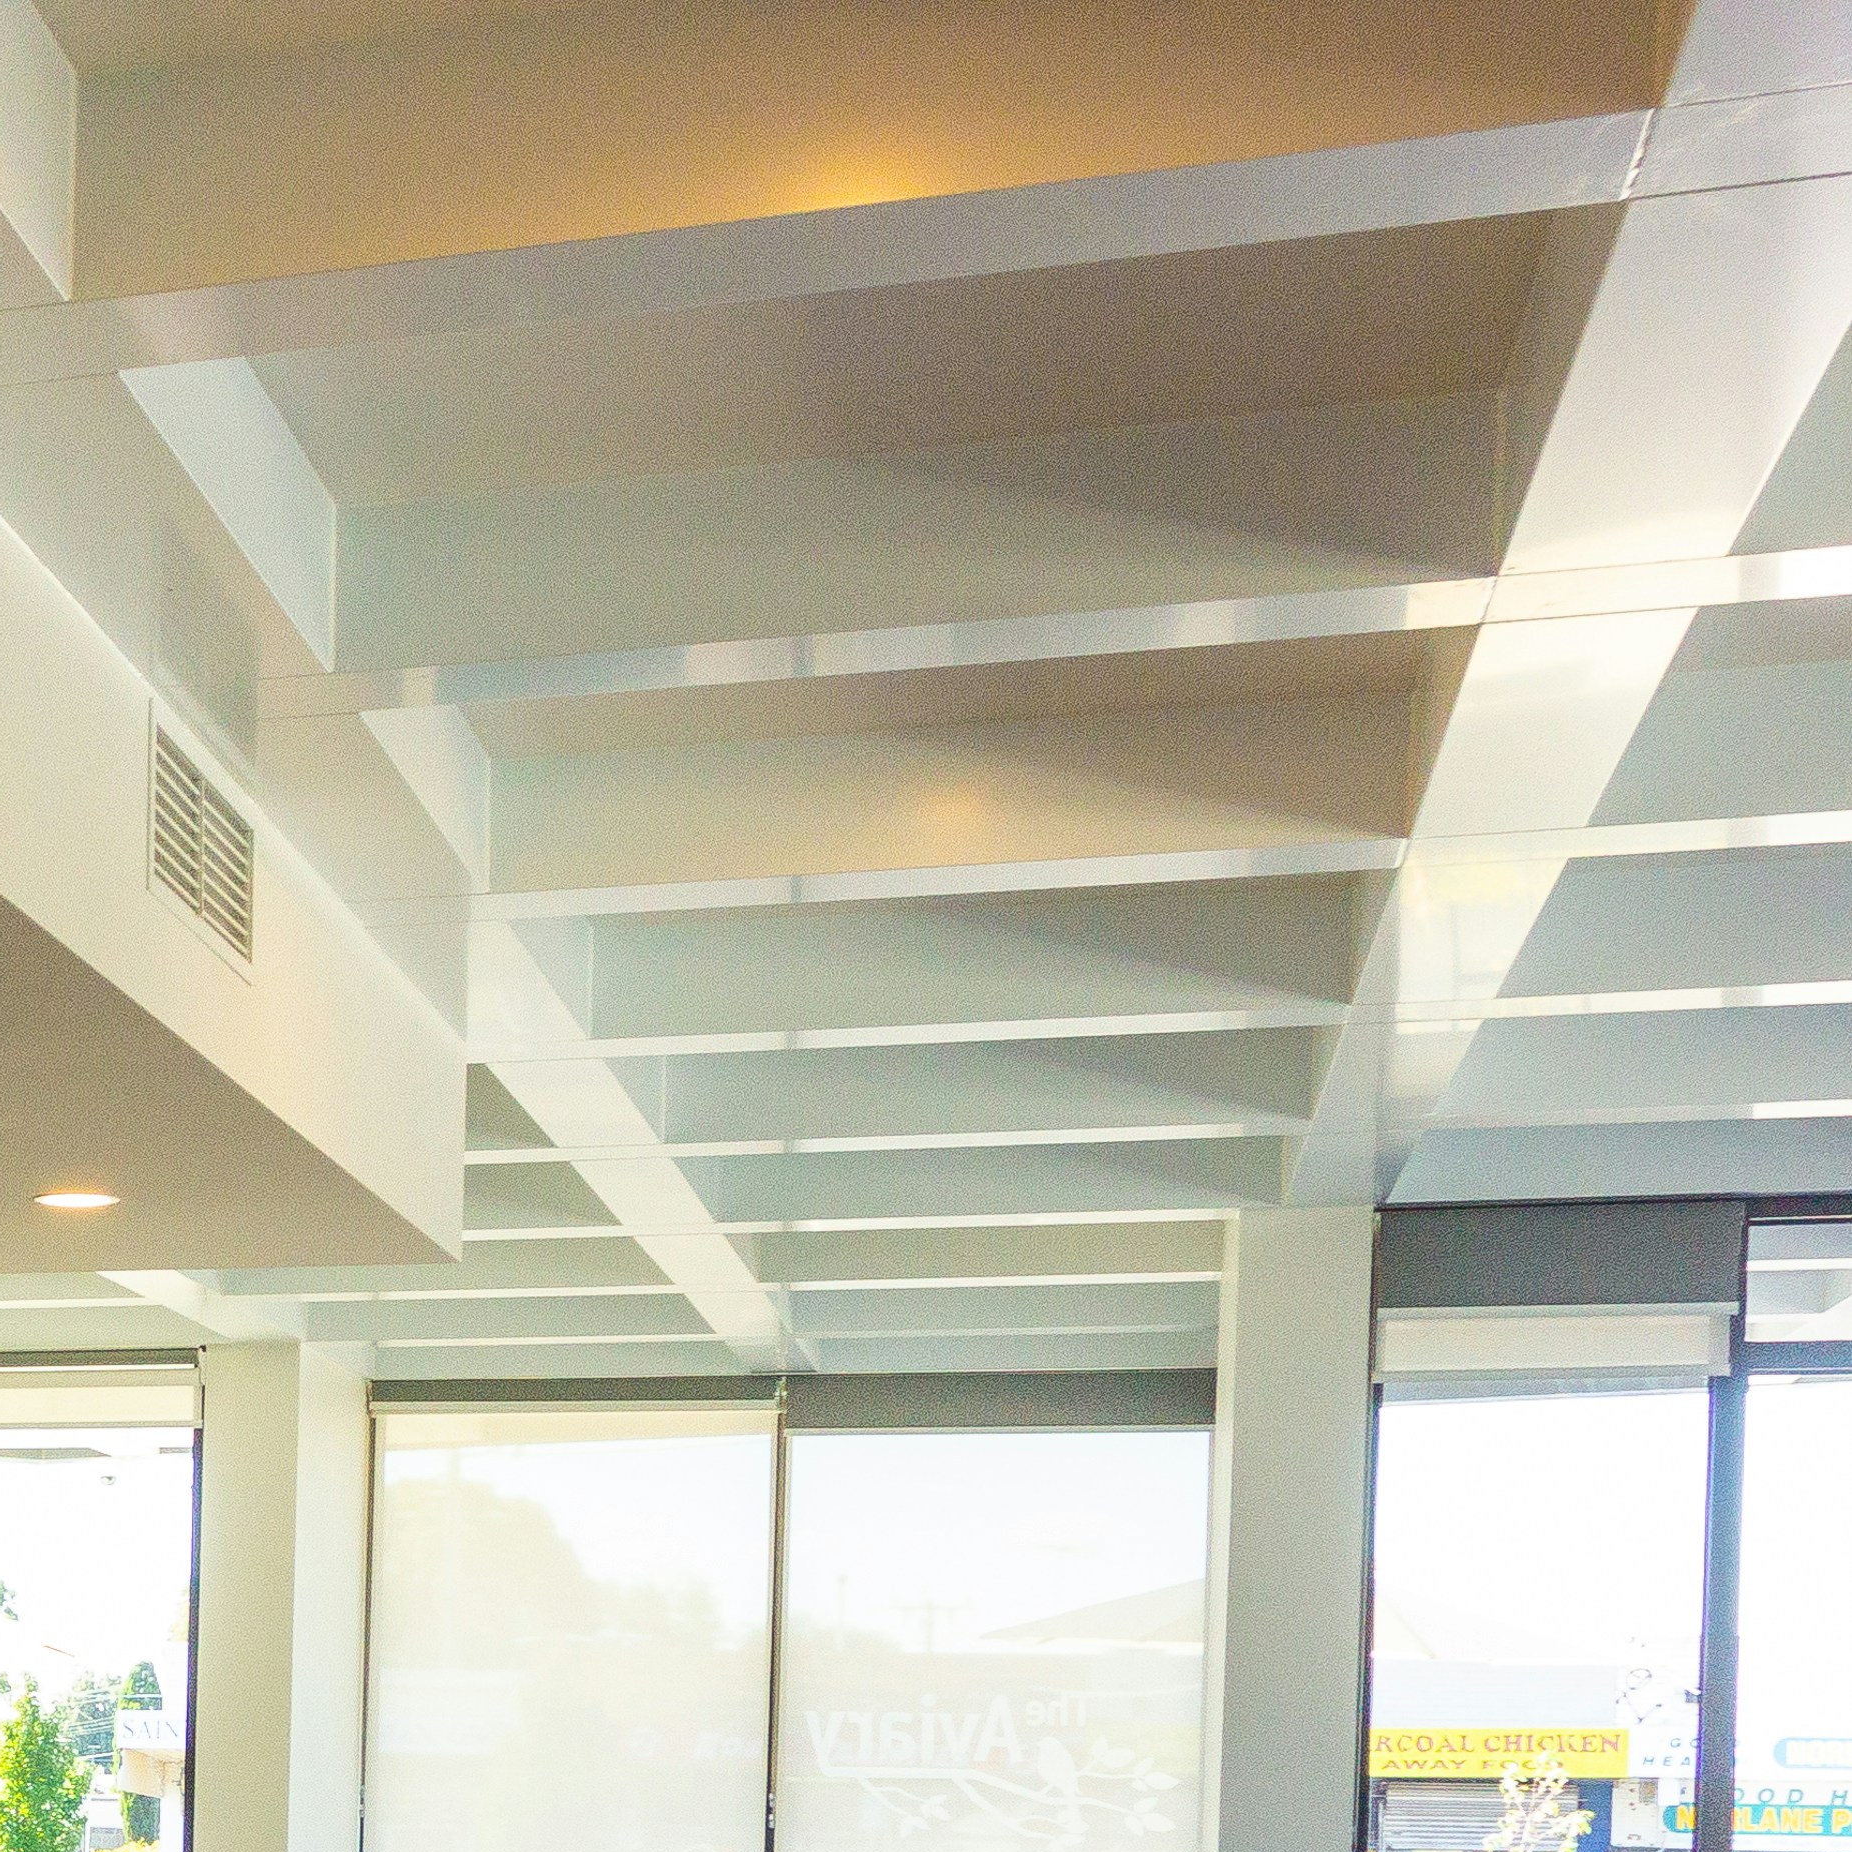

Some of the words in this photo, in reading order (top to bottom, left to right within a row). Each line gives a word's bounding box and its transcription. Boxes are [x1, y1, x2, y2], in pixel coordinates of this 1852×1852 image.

[1372, 1734, 1477, 1754] RCOAL
[1485, 1734, 1622, 1754] CHICKEN
[1381, 1759, 1469, 1771] AWAY
[1676, 1806, 1824, 1834] NRLANE
